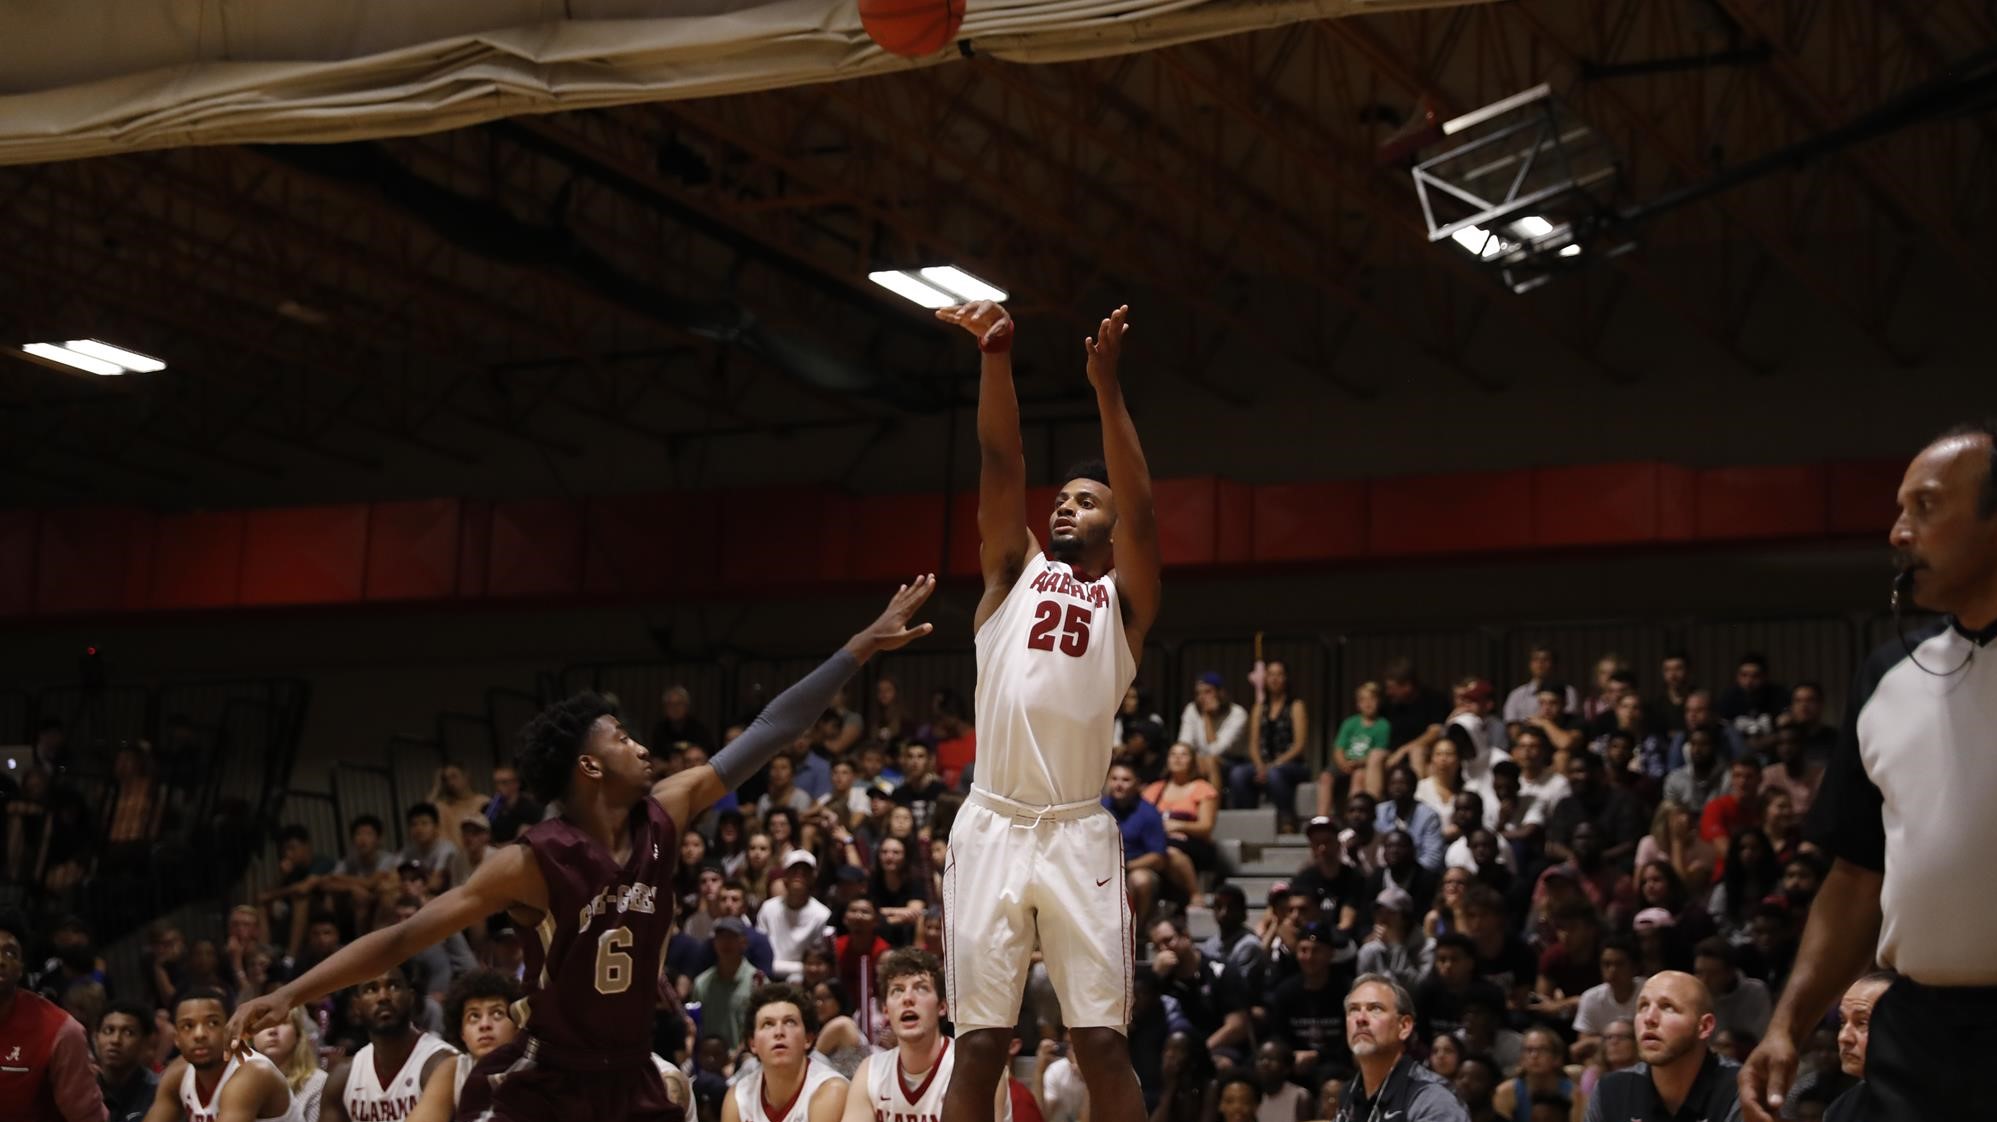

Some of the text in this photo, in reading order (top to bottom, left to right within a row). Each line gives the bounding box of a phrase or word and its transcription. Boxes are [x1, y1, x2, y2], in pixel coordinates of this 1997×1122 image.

[1029, 570, 1110, 609] AABAMA
[1027, 600, 1092, 658] 25
[594, 925, 634, 995] 6
